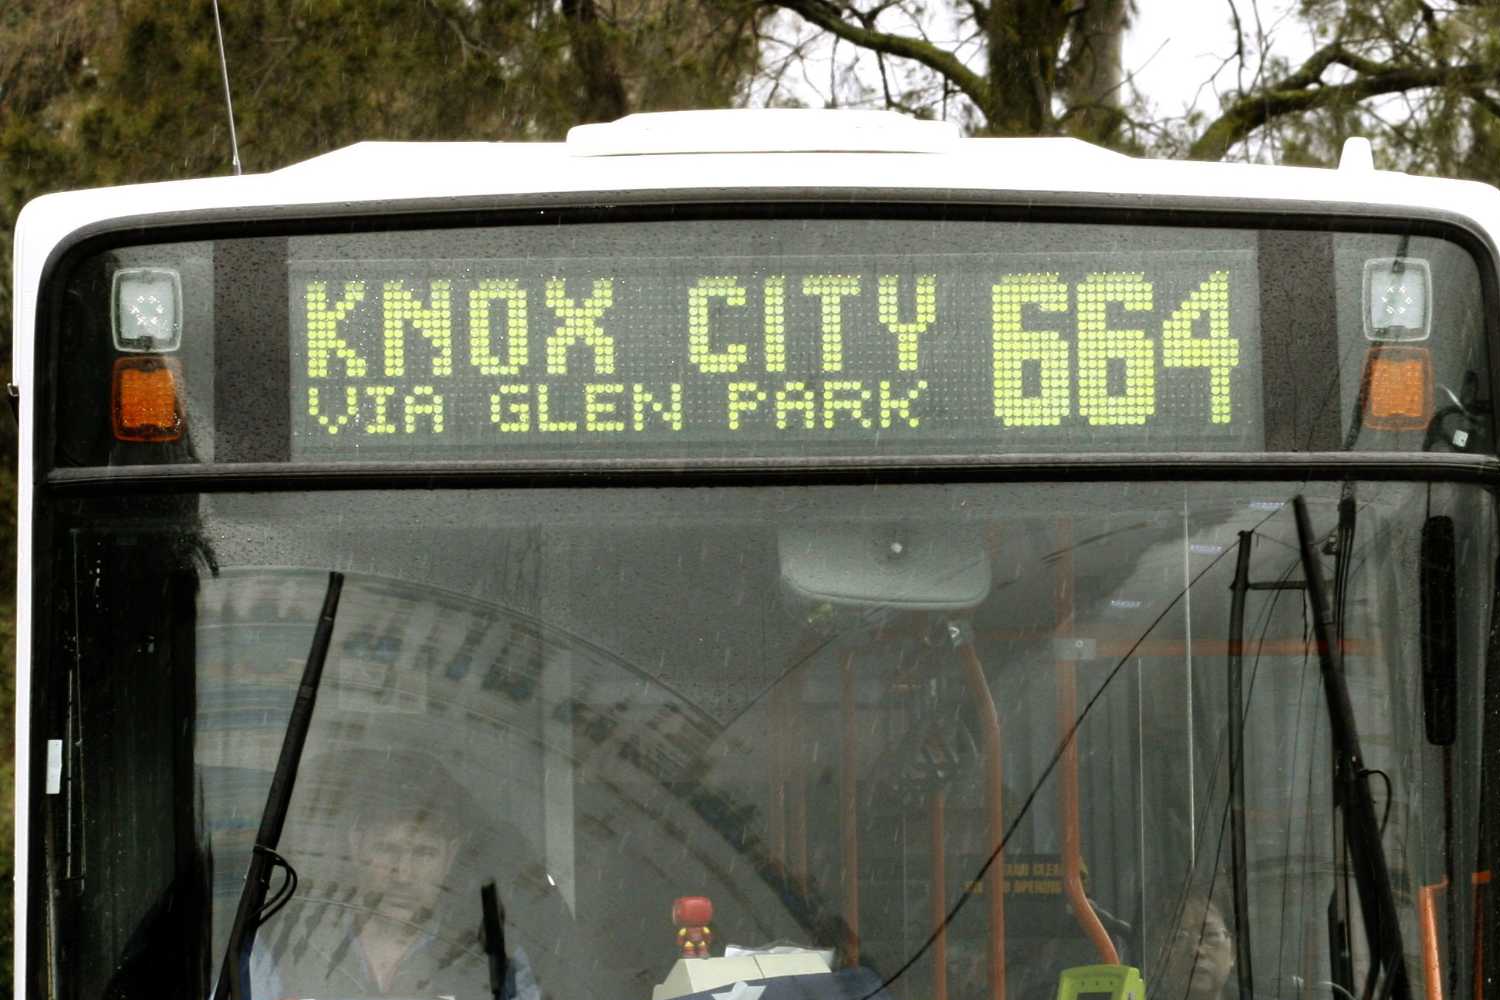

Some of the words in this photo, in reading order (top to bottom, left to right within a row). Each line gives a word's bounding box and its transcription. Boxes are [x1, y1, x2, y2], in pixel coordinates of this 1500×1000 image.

[307, 278, 615, 377] KNOX
[688, 276, 936, 373] CITY
[992, 273, 1240, 426] 664
[307, 384, 444, 435] VIA
[491, 384, 683, 432] GLEN
[728, 381, 928, 430] PARK
